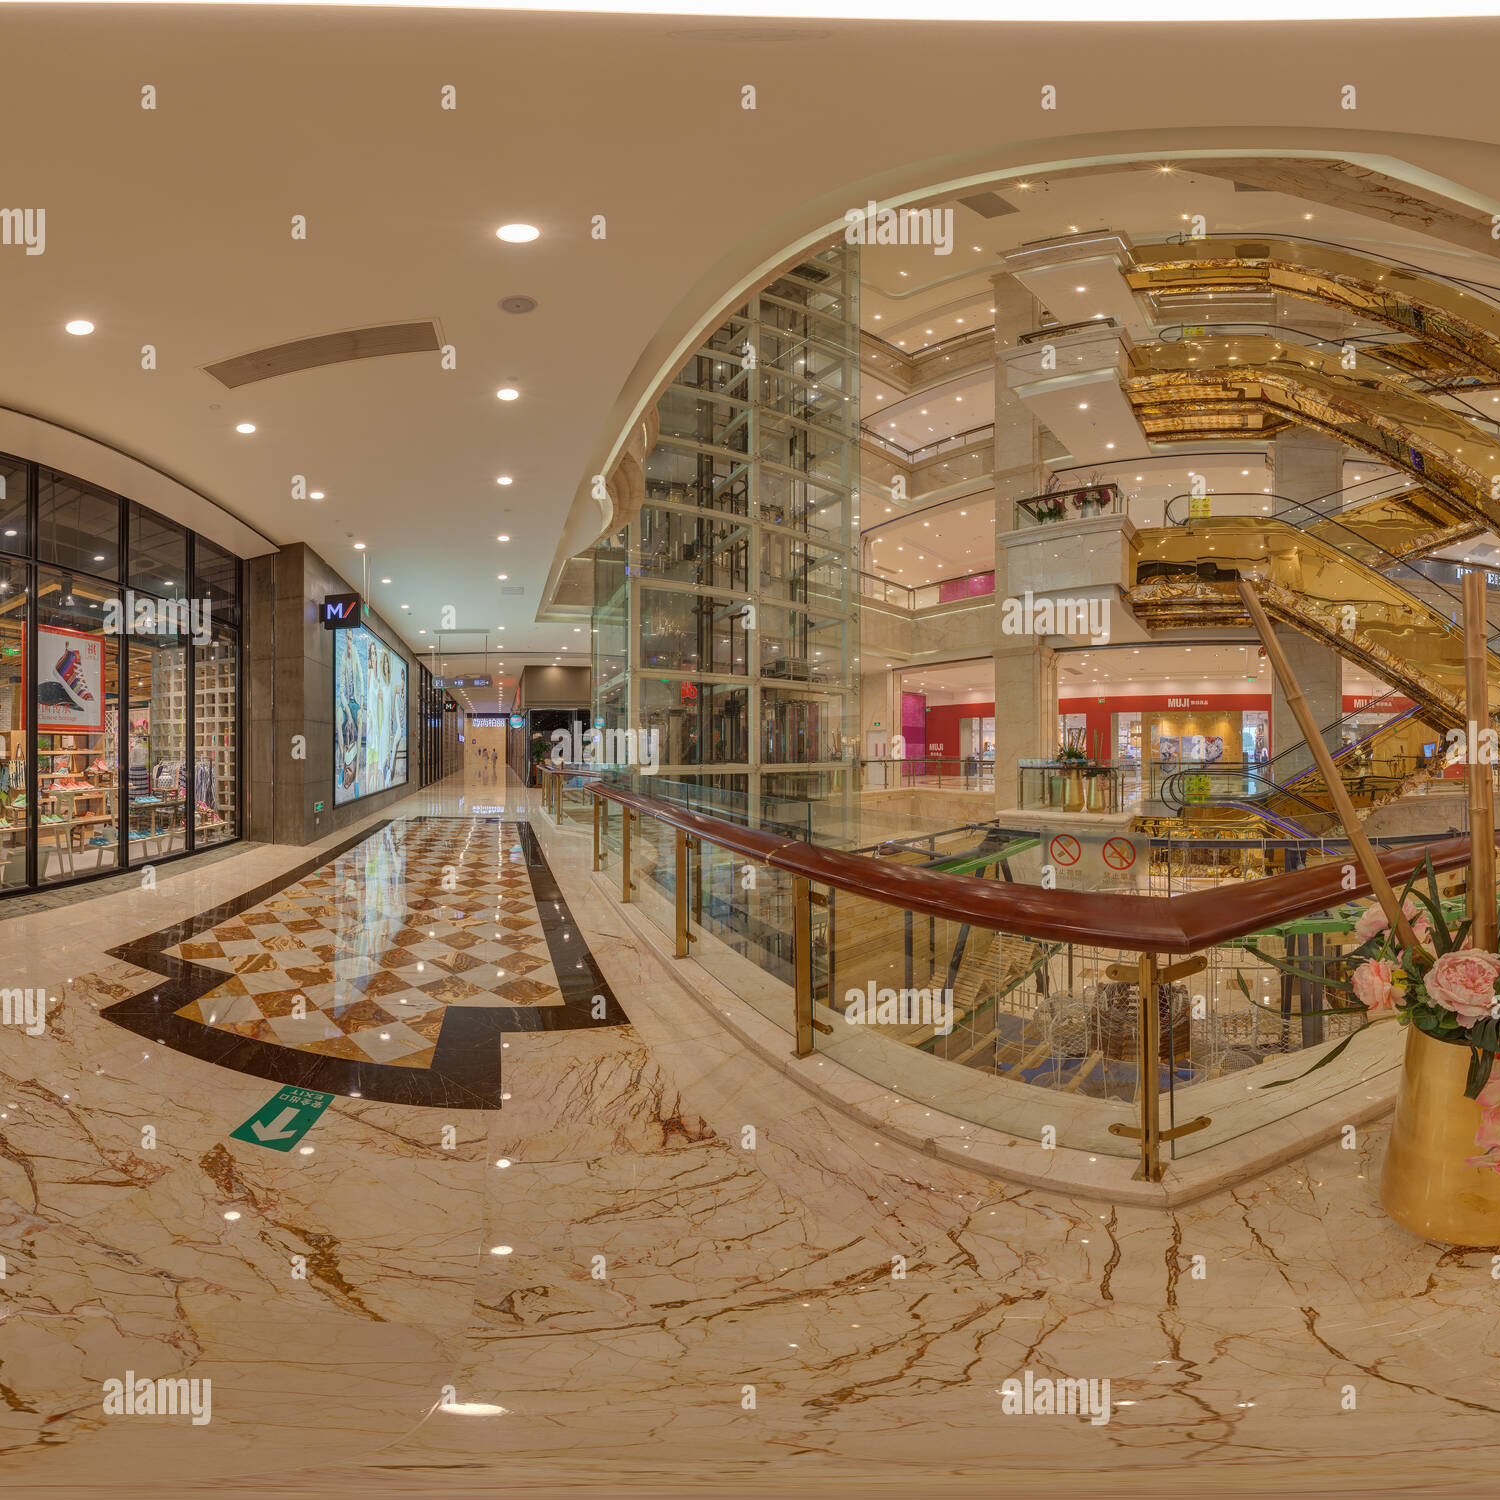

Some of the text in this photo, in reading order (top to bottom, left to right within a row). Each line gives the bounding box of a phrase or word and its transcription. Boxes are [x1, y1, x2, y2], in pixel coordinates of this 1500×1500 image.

[1167, 697, 1190, 708] MUJI
[928, 743, 944, 751] MUJI
[290, 1089, 324, 1101] EXIT
[279, 1093, 324, 1109] 安全出口
